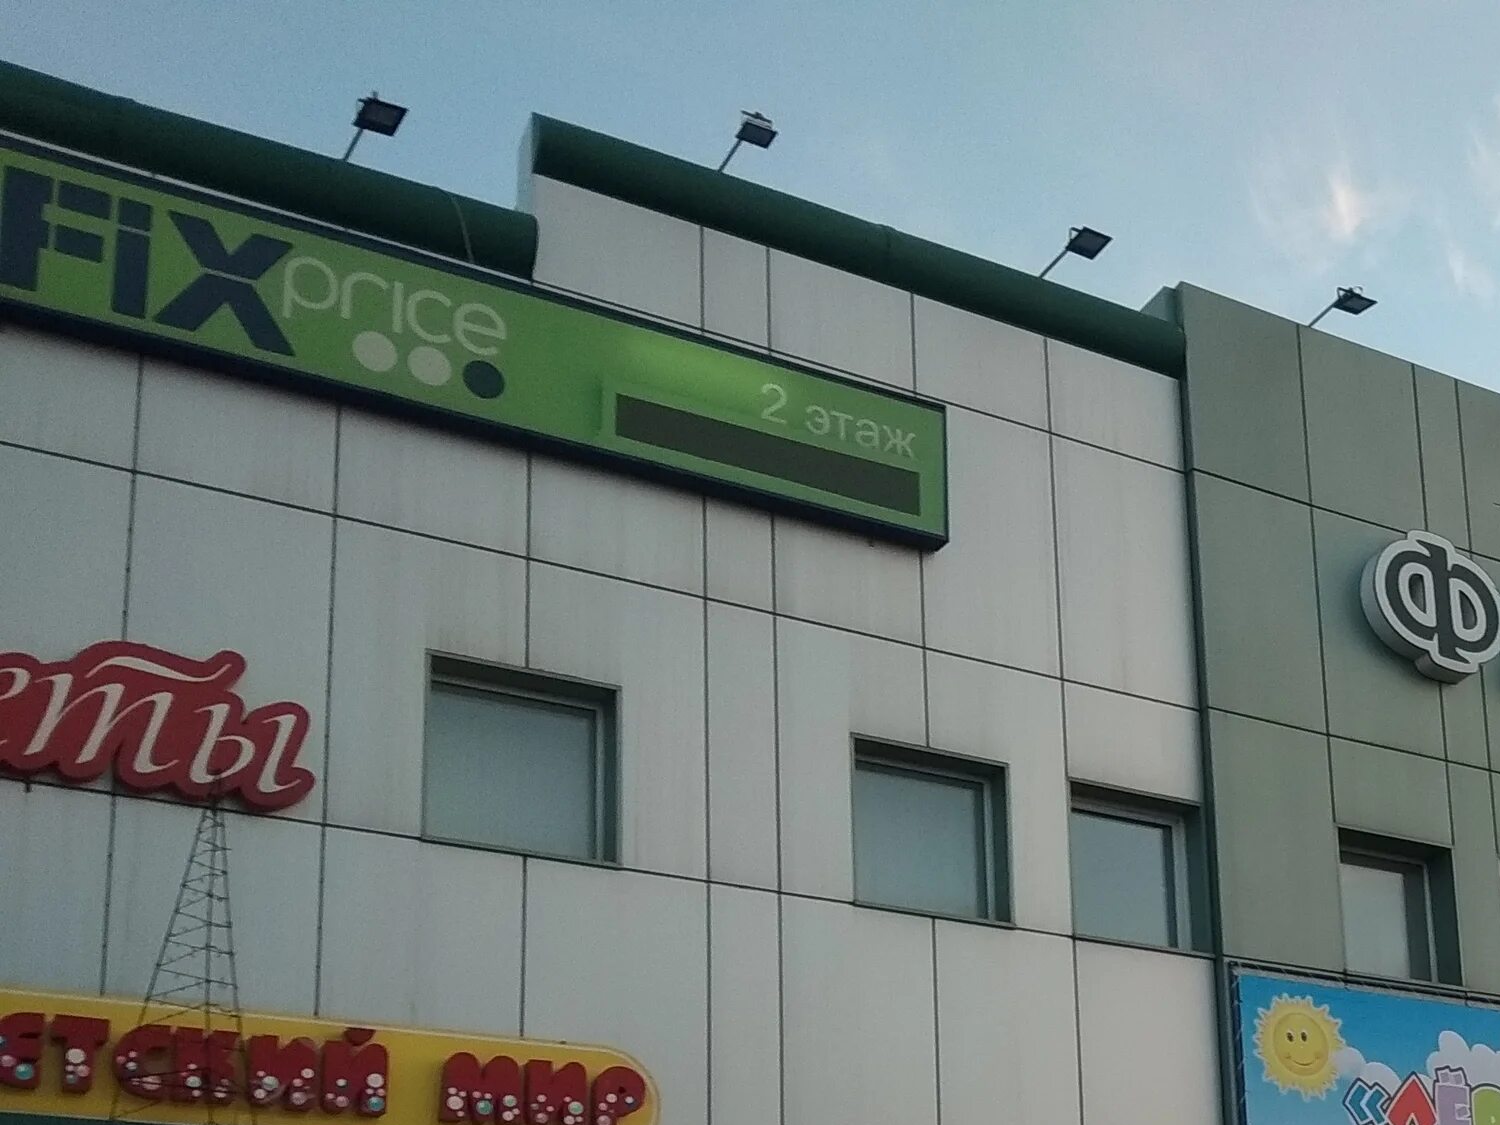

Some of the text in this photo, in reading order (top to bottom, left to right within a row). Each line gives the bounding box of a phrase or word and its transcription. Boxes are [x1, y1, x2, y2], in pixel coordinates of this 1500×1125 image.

[282, 256, 507, 355] price
[761, 383, 916, 459] 2 этаж
